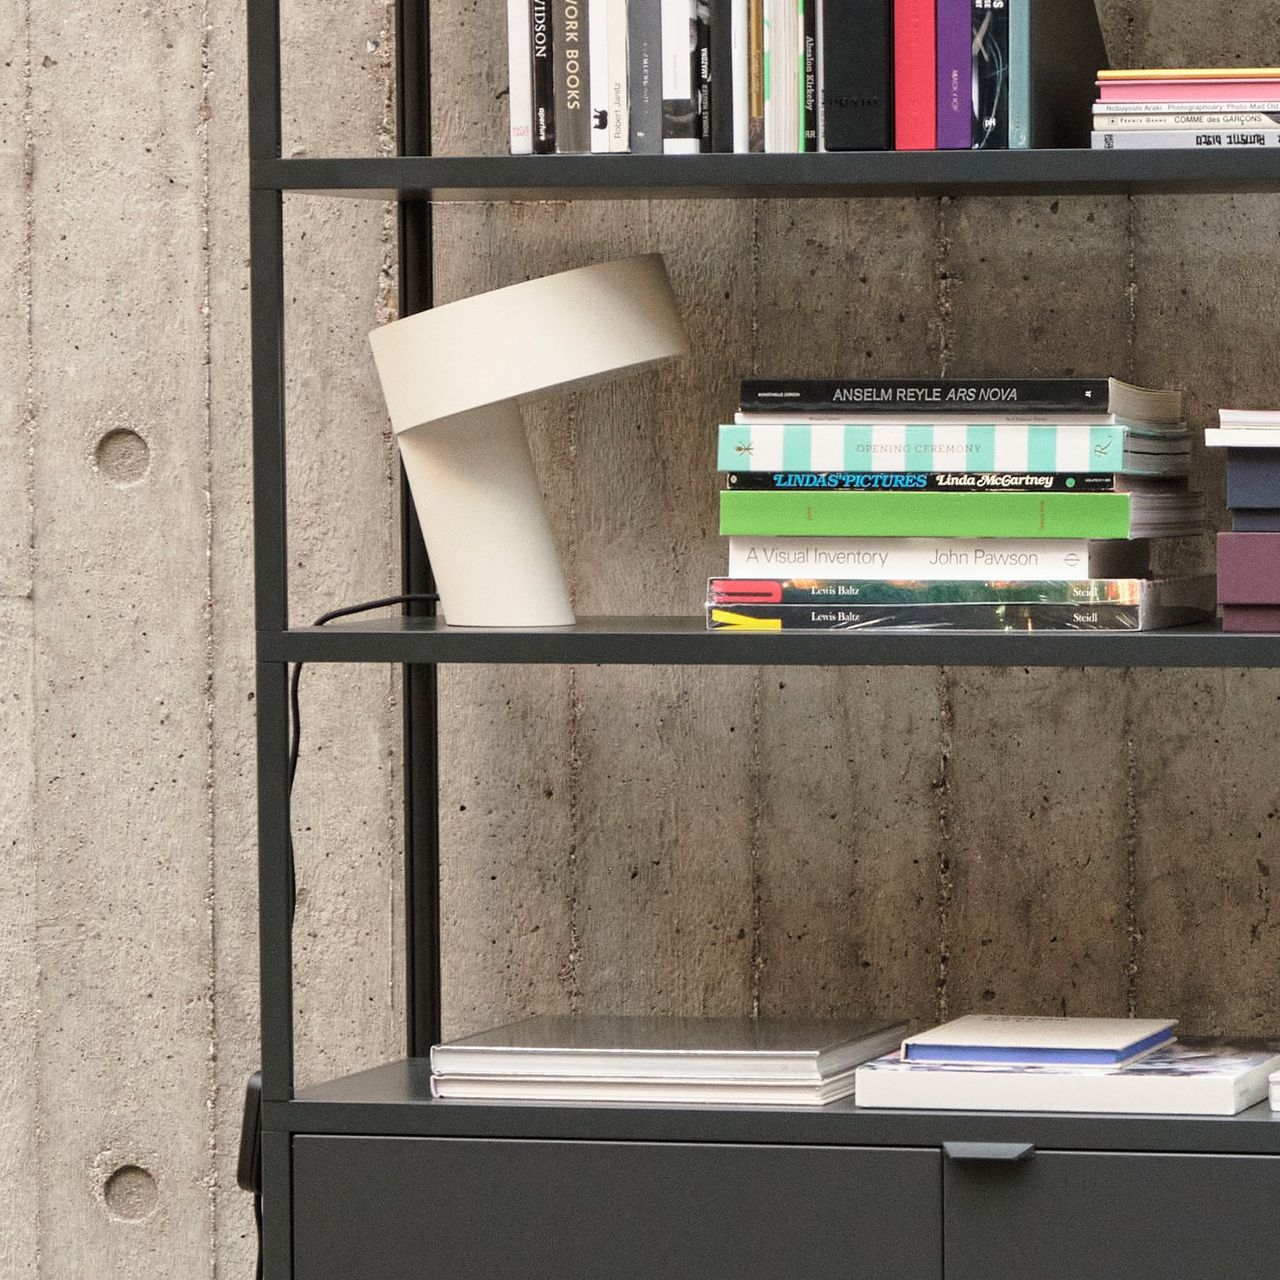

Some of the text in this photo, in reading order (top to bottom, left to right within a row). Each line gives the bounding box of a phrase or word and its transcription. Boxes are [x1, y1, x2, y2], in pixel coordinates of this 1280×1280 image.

[565, 49, 580, 110] BOOKS
[804, 35, 815, 111] Absalon Kirkeby
[538, 107, 547, 141] aperture
[1174, 116, 1204, 124] COMME
[833, 388, 1018, 401] ANSELM REYLE ARS NOVA
[856, 444, 982, 454] OPENING CEREMONY
[936, 474, 1054, 488] Linda McCartney
[746, 547, 889, 568] A Visual Inventory
[929, 549, 1038, 566] John Pawson
[811, 585, 860, 596] Lewis Baltz
[811, 611, 860, 622] Lewis Baltz
[1072, 612, 1099, 622] Steidl
